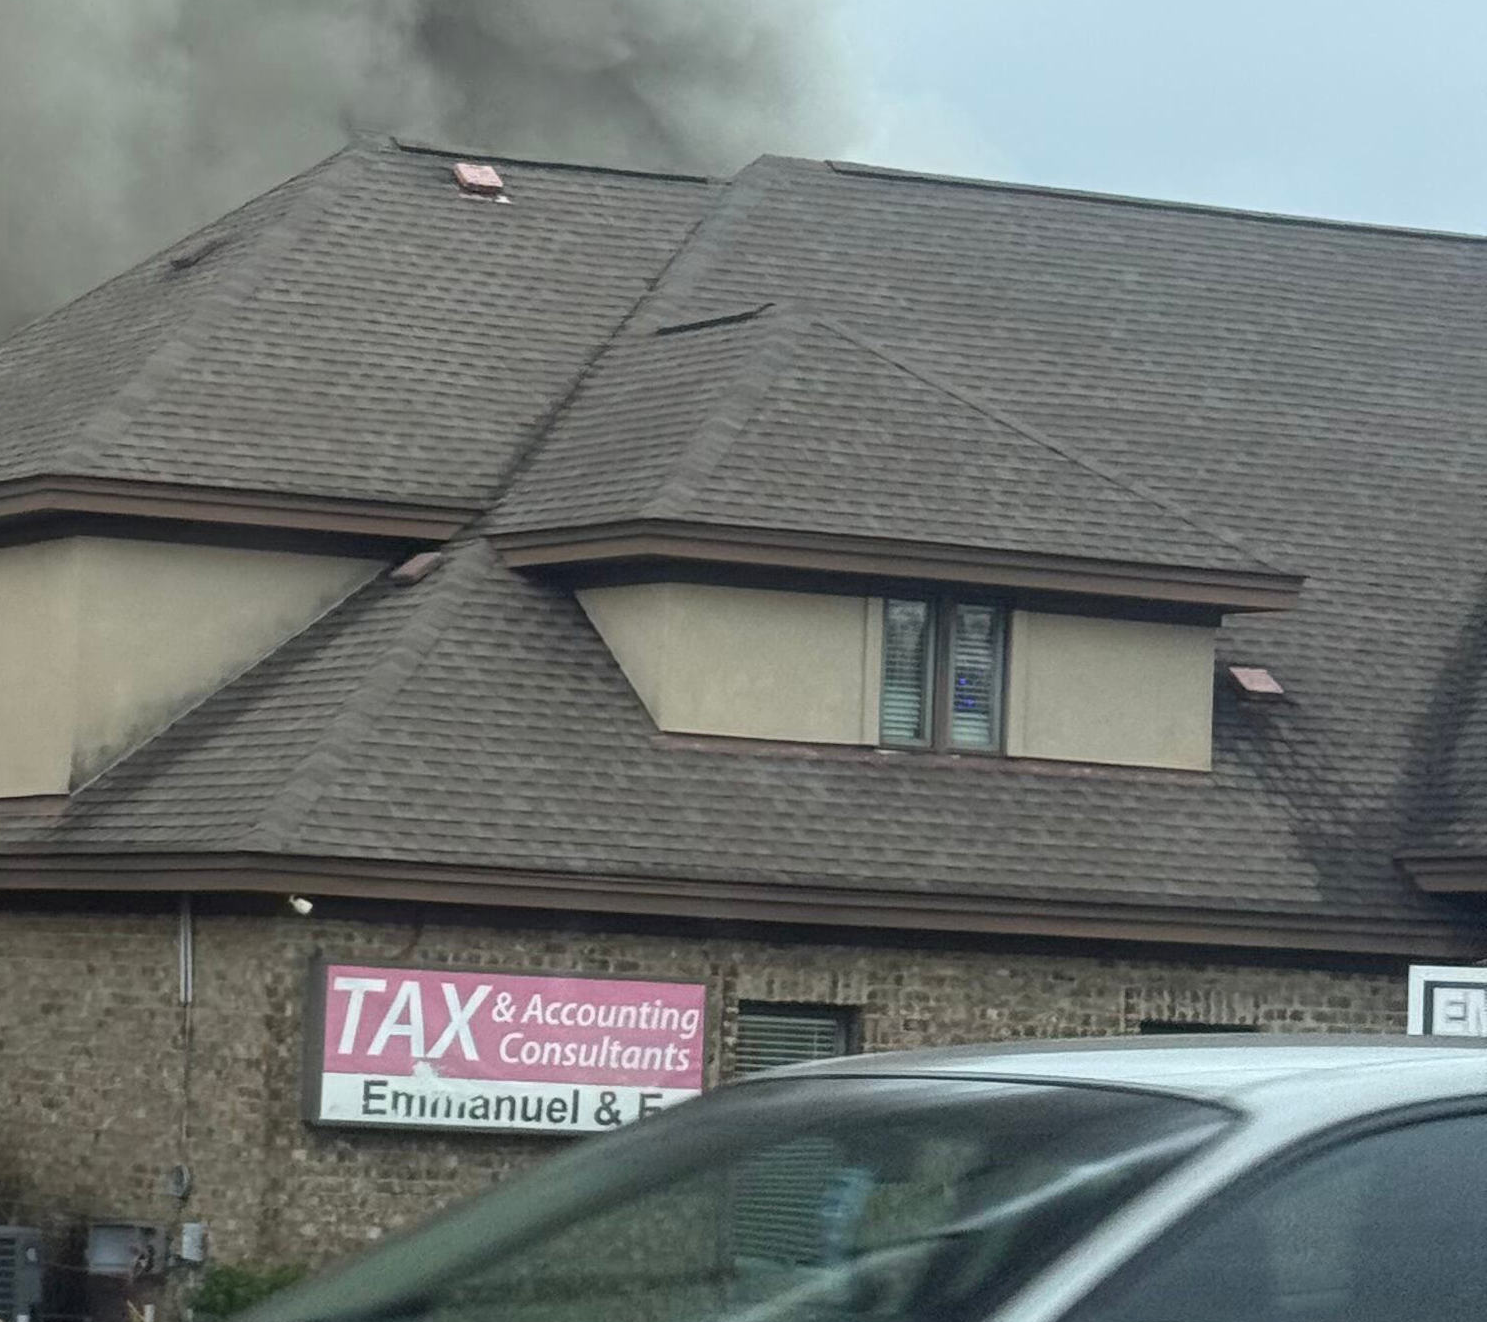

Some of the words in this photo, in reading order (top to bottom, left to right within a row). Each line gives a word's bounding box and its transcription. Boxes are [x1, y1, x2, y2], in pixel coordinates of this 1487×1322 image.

[333, 977, 493, 1062] TAX
[491, 991, 513, 1021] &
[521, 992, 700, 1040] Accounting
[499, 1031, 690, 1073] Consultants
[594, 1090, 622, 1126] &
